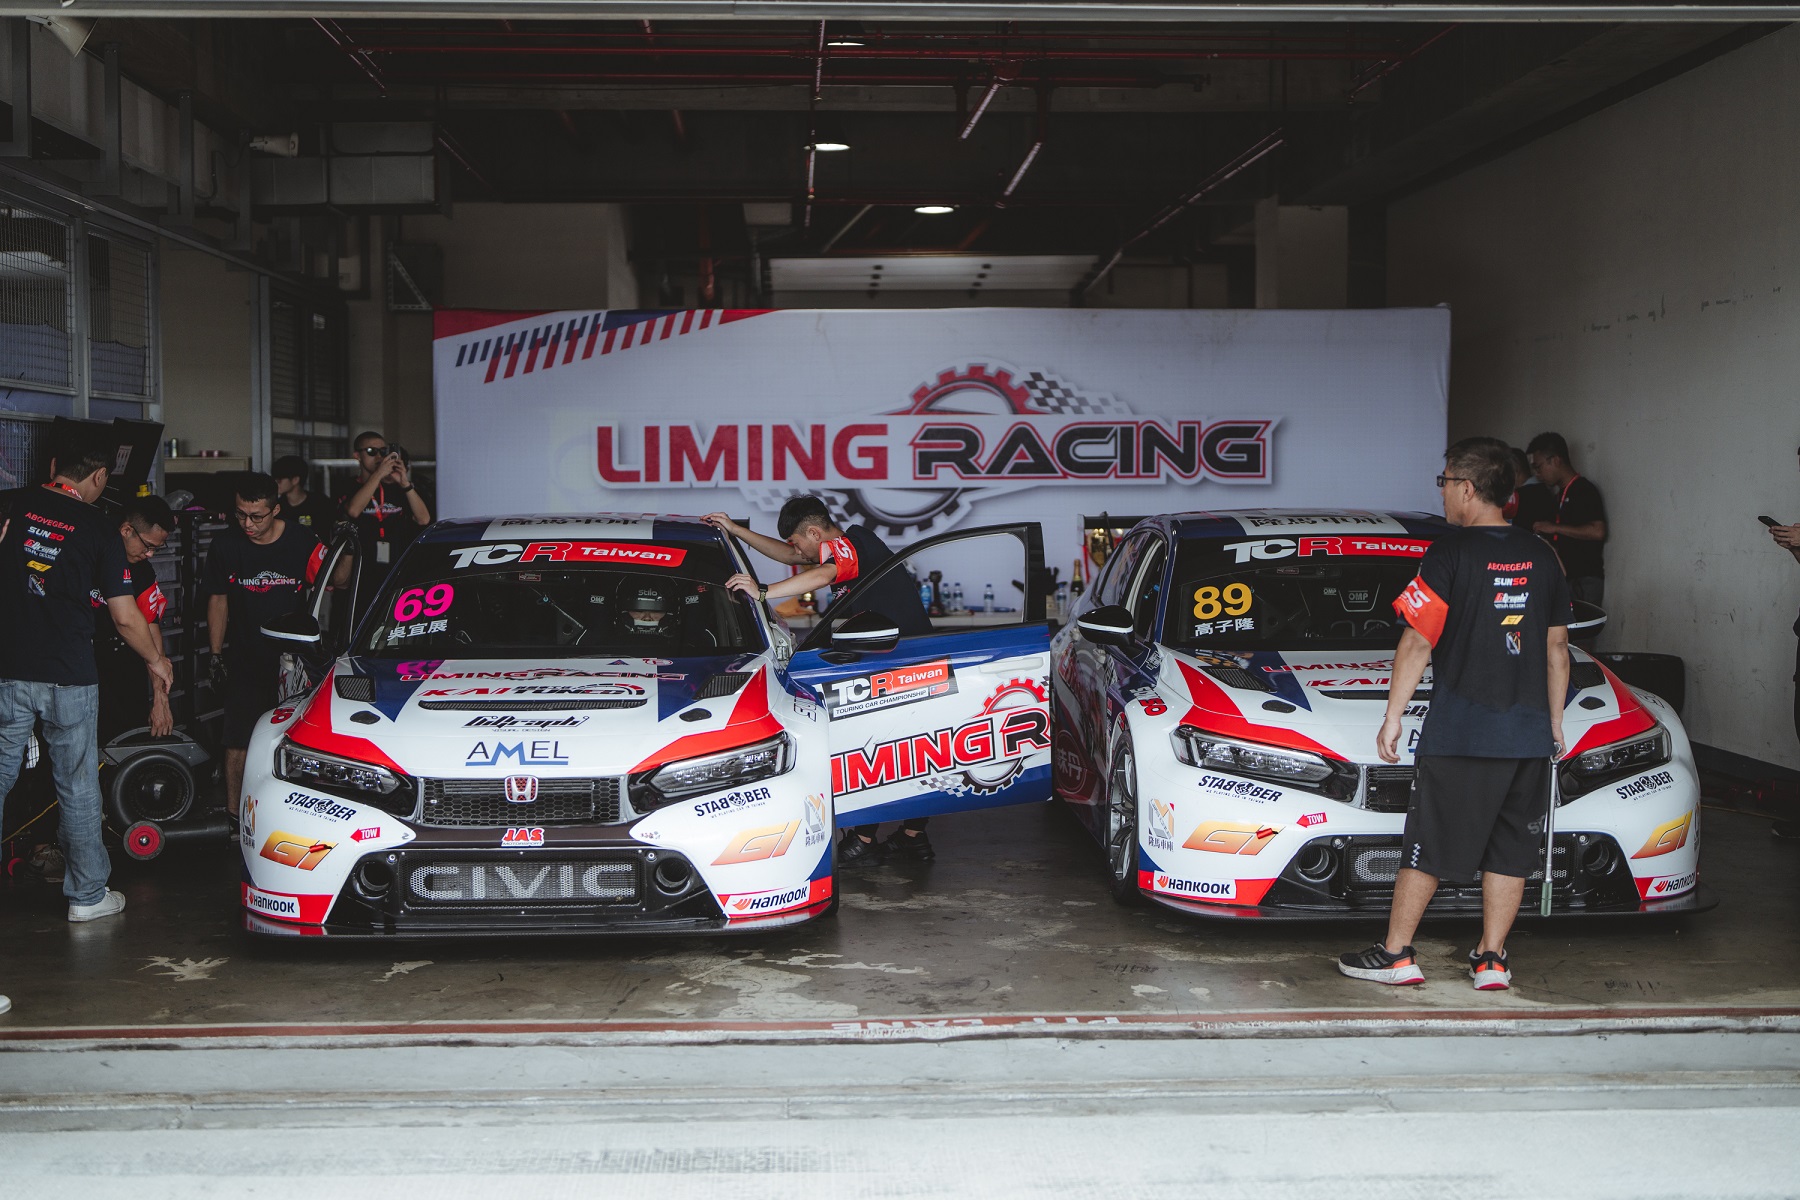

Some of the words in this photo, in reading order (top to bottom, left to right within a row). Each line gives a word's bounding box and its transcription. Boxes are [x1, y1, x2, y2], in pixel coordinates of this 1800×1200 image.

[596, 424, 889, 483] LIMING
[911, 419, 1275, 481] RACING
[25, 511, 76, 532] ABOVEGEAR
[28, 525, 65, 541] SUNSO
[450, 541, 573, 568] TCR
[580, 547, 672, 561] Taiwan
[1223, 536, 1343, 564] TCR
[1352, 541, 1429, 553] Taiwa
[1487, 561, 1533, 572] ABOVEGEAR
[1494, 577, 1528, 586] SUNSO
[394, 583, 454, 622] 69
[1193, 583, 1253, 620] 89
[1348, 592, 1369, 601] OMP
[387, 619, 448, 641] 吳宜展
[1194, 617, 1255, 637] 高子隆
[400, 671, 527, 681] LIMING
[534, 671, 687, 681] RACING
[1261, 662, 1392, 673] LIMING
[417, 687, 511, 696] KAI
[832, 672, 894, 705] TCR
[897, 667, 943, 686] Taiwan
[836, 702, 864, 715] TOURING
[865, 700, 878, 709] CAR
[879, 690, 927, 706] CHAMPIONSHIP
[466, 741, 569, 766] AMEL
[1307, 813, 1325, 824] TOW
[361, 828, 378, 839] TOW
[503, 828, 543, 842] JAS
[410, 864, 635, 899] CIVIC
